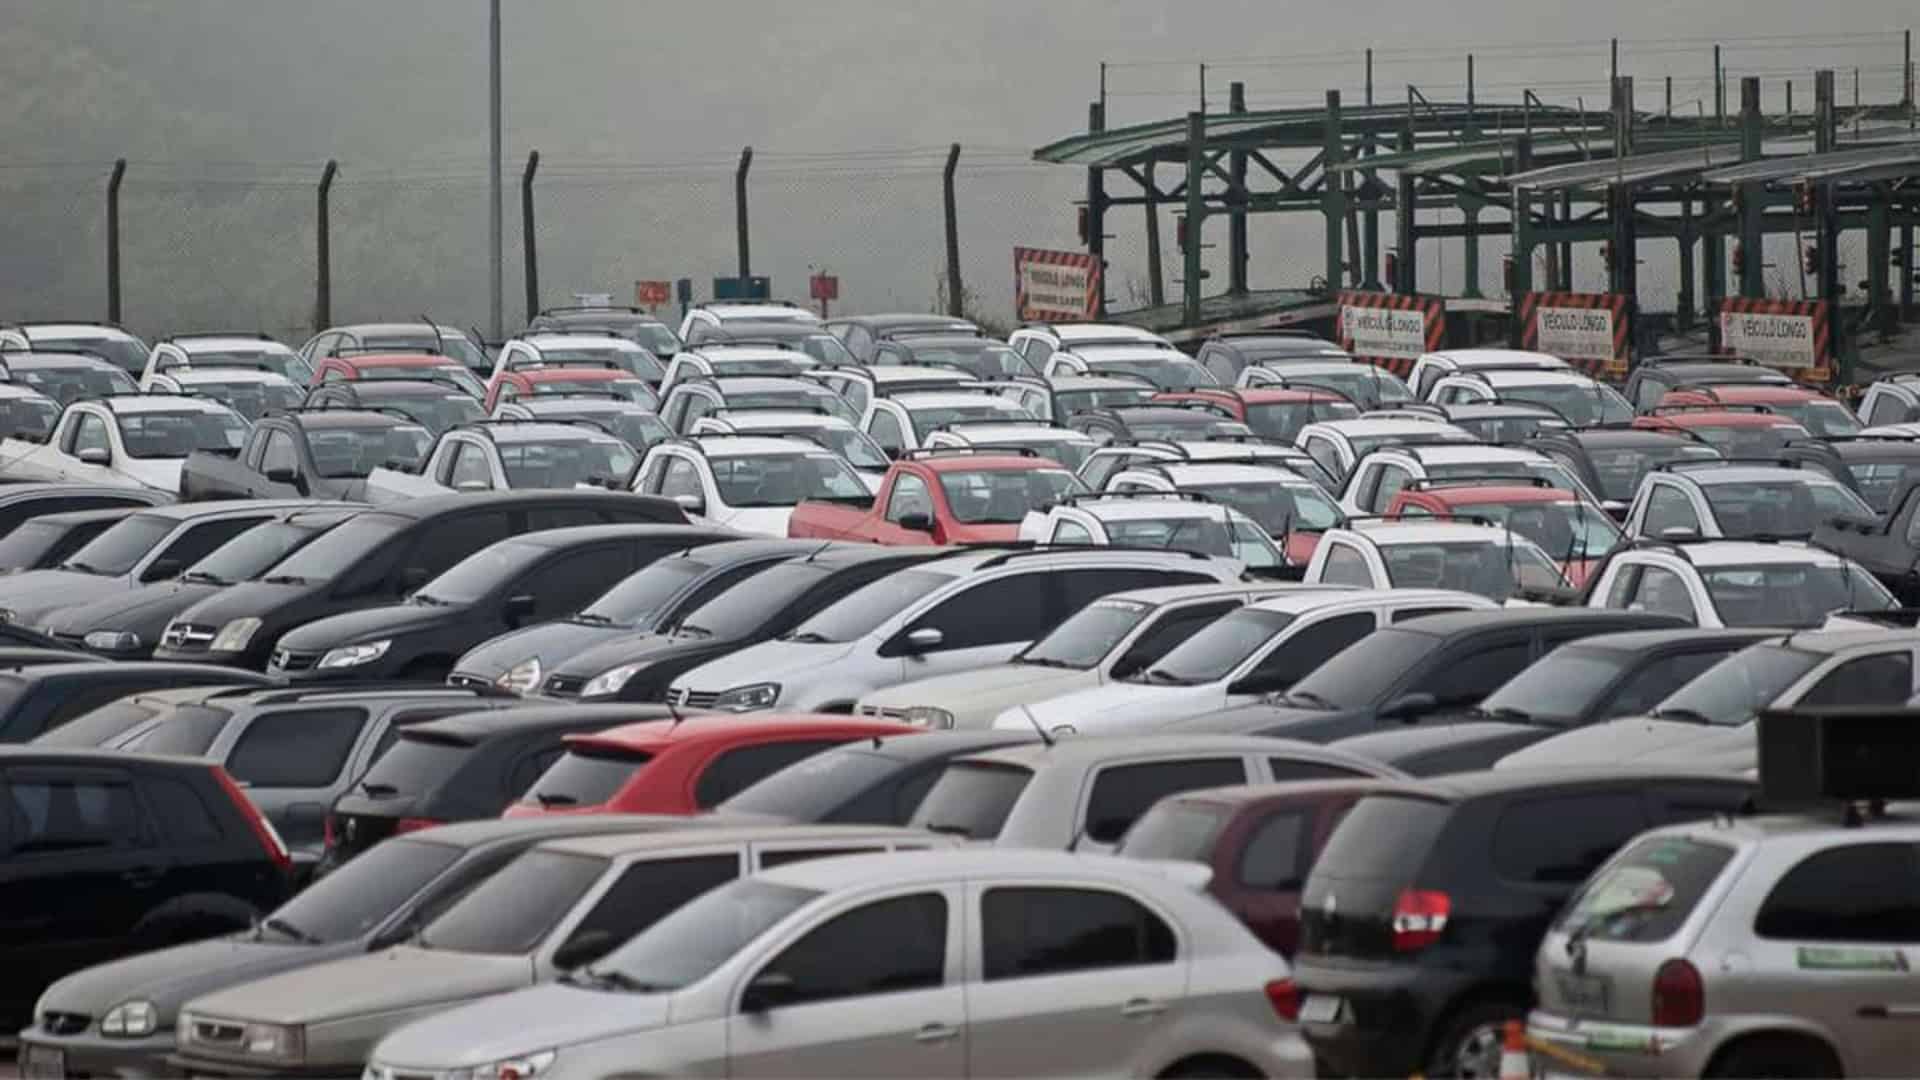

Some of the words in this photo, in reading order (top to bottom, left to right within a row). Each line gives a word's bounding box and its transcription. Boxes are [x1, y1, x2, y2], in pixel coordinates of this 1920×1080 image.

[1392, 318, 1420, 333] LONGO
[1579, 314, 1607, 332] LONGO
[1776, 320, 1806, 339] LONGO
